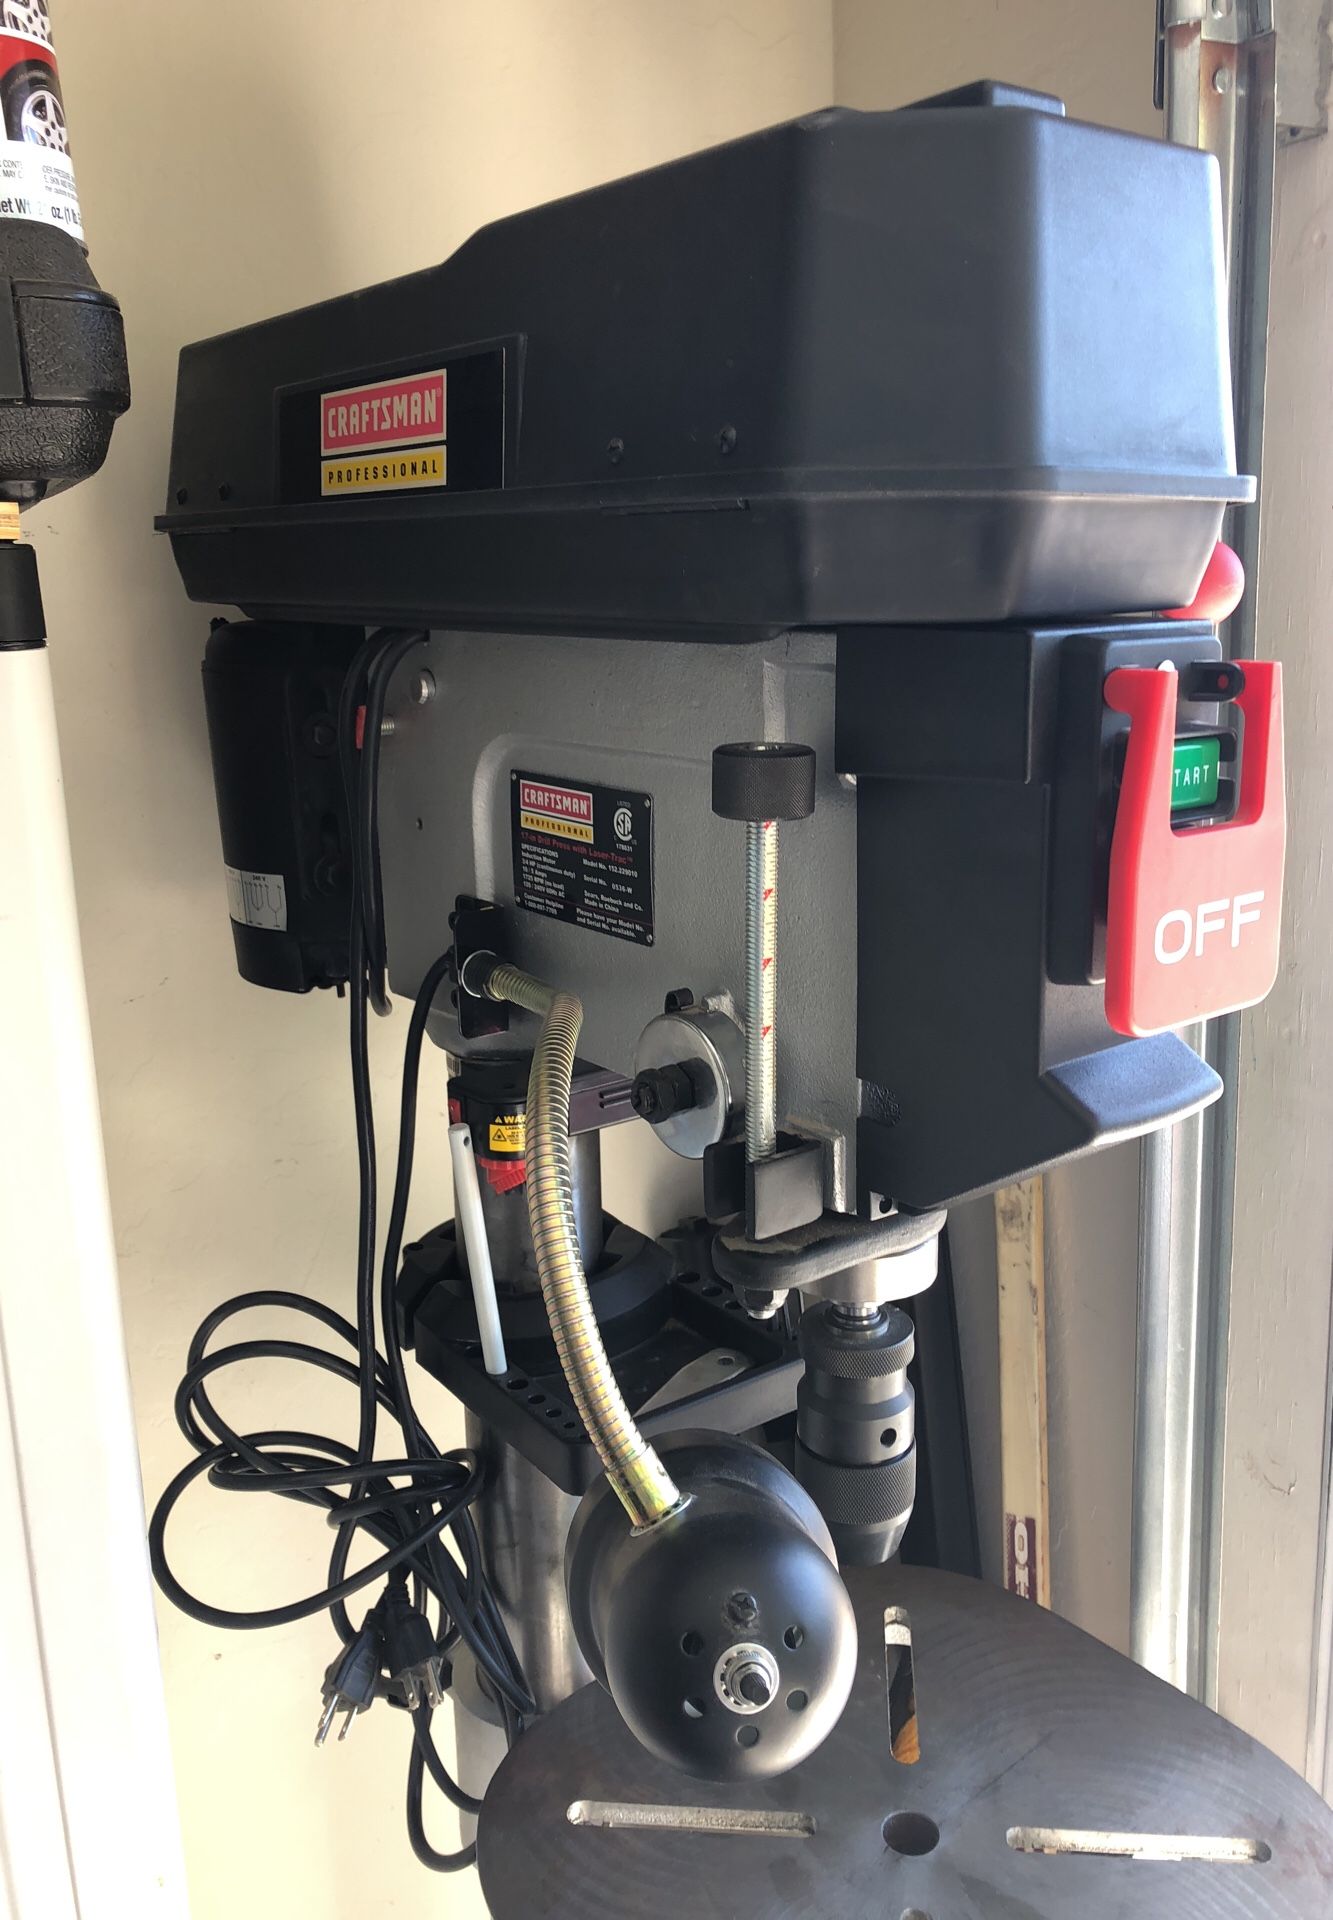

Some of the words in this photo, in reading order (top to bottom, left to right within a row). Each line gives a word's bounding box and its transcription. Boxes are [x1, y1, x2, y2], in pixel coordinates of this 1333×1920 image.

[328, 388, 437, 438] CRAFTSMAN
[328, 459, 438, 484] PROFESSIONAL
[1173, 764, 1210, 787] TART
[524, 788, 588, 816] CRAFTSMAN
[525, 816, 590, 838] PROFESSIONAL
[521, 843, 558, 858] SPECIFICATIONS
[522, 851, 542, 861] Induction
[542, 856, 556, 865] Motor
[552, 838, 571, 850] Press
[572, 845, 587, 856] with
[582, 858, 598, 868] Model
[599, 862, 608, 871] No.
[584, 874, 598, 884] Serial
[598, 878, 608, 888] No.
[524, 892, 544, 904] Customer
[584, 890, 600, 900] Sears,
[600, 894, 622, 906] Roebuck
[623, 899, 634, 910] and
[634, 903, 644, 912] Co.
[584, 898, 598, 907] Made
[604, 904, 620, 914] China
[576, 907, 592, 918] Please
[593, 911, 606, 922] have
[606, 916, 618, 926] your
[618, 918, 634, 930] Model
[635, 924, 644, 932] No.
[576, 916, 586, 924] and
[586, 918, 601, 928] Serial
[602, 922, 610, 931] No.
[611, 924, 636, 938] available.
[1153, 889, 1266, 966] OFF
